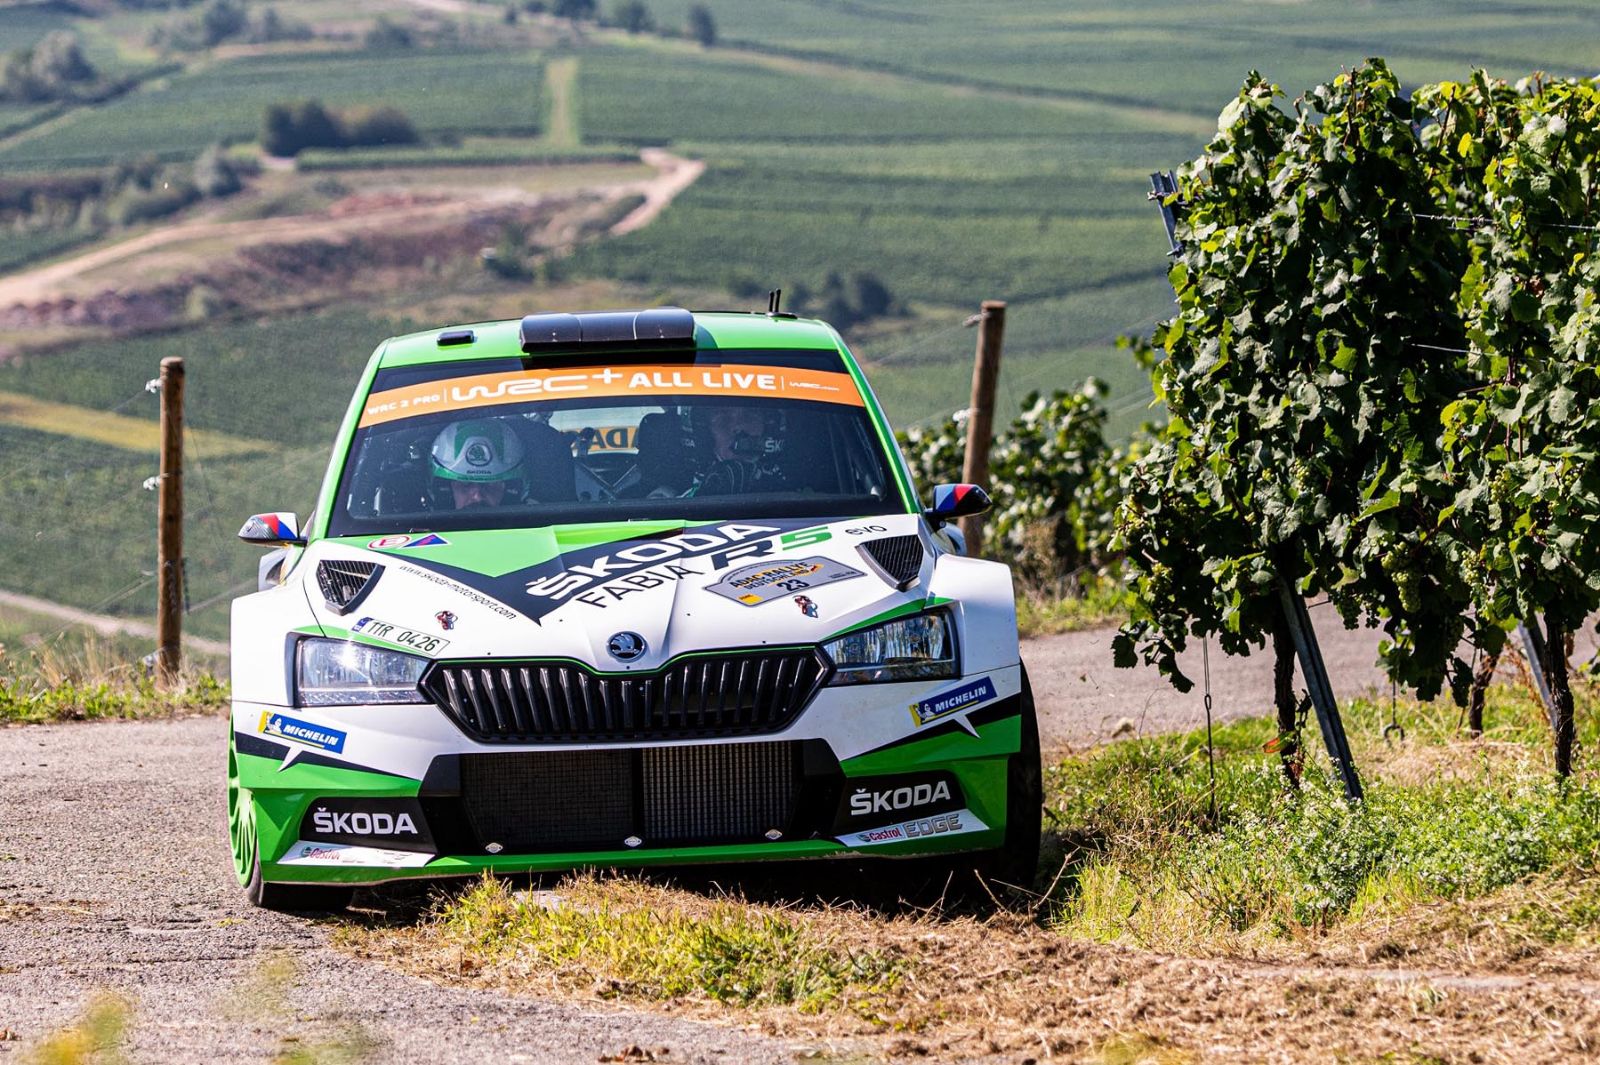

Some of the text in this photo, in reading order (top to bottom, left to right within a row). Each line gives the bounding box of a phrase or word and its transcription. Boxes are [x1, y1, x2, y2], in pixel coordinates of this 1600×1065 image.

[628, 372, 693, 388] ALL
[702, 372, 777, 390] LIVE
[368, 402, 397, 415] WRC
[413, 394, 440, 405] PRO
[524, 524, 783, 600] ŠKODA
[576, 563, 705, 609] FABIA
[776, 579, 810, 591] 23
[397, 631, 440, 651] 0426
[935, 686, 987, 712] MICHELIN
[283, 724, 338, 746] MICHELIN
[851, 780, 951, 815] ŠKODA
[313, 807, 418, 835] ŠKODA
[869, 814, 963, 842] Castrol EDGE
